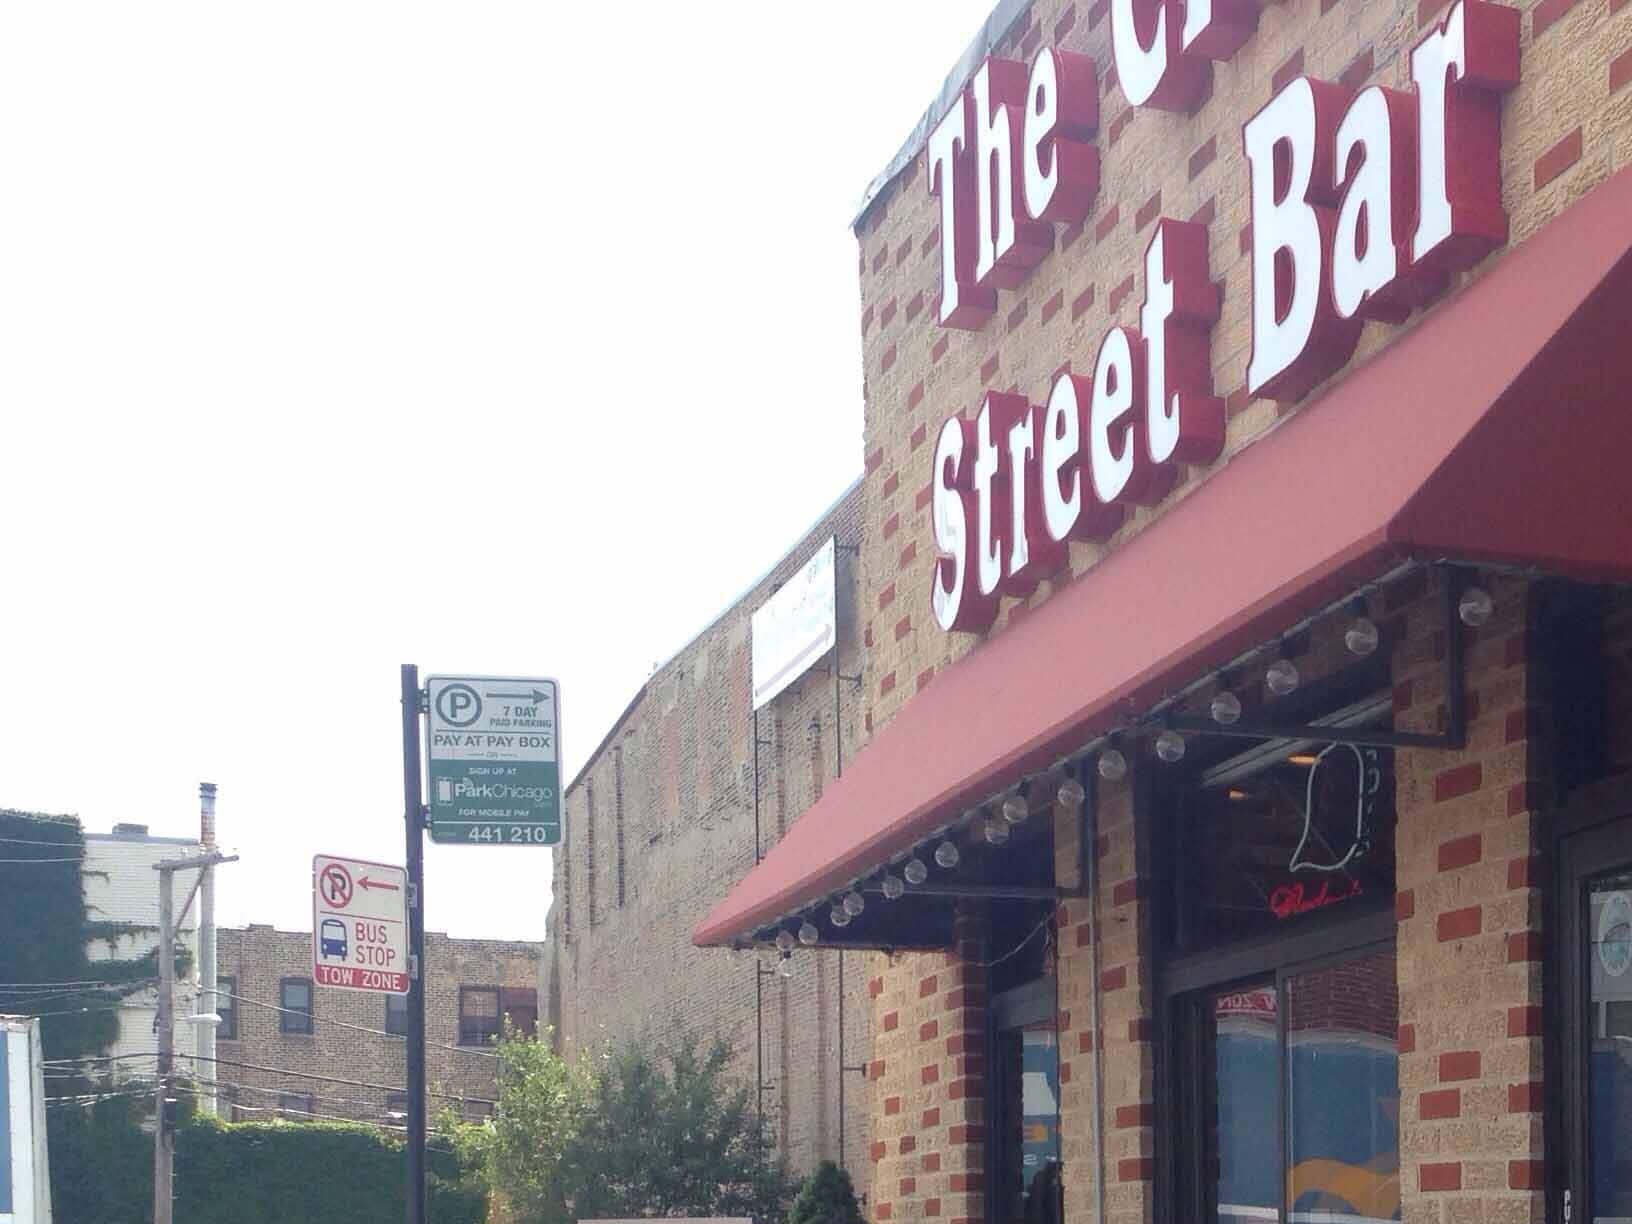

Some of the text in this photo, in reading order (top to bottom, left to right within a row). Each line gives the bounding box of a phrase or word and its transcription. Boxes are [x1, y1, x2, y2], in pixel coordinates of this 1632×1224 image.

[928, 47, 1058, 325] The
[931, 0, 1466, 631] Street Bar
[450, 692, 471, 718] P
[503, 706, 538, 717] 7 DAY
[513, 719, 552, 729] PARKING
[434, 736, 550, 748] PAY AT PAY BOX
[492, 767, 504, 775] UP
[455, 783, 553, 802] ParkChicago
[468, 826, 546, 842] 441 210
[355, 922, 388, 944] BUS
[355, 946, 396, 967] STOP
[320, 967, 401, 990] TOW ZONE
